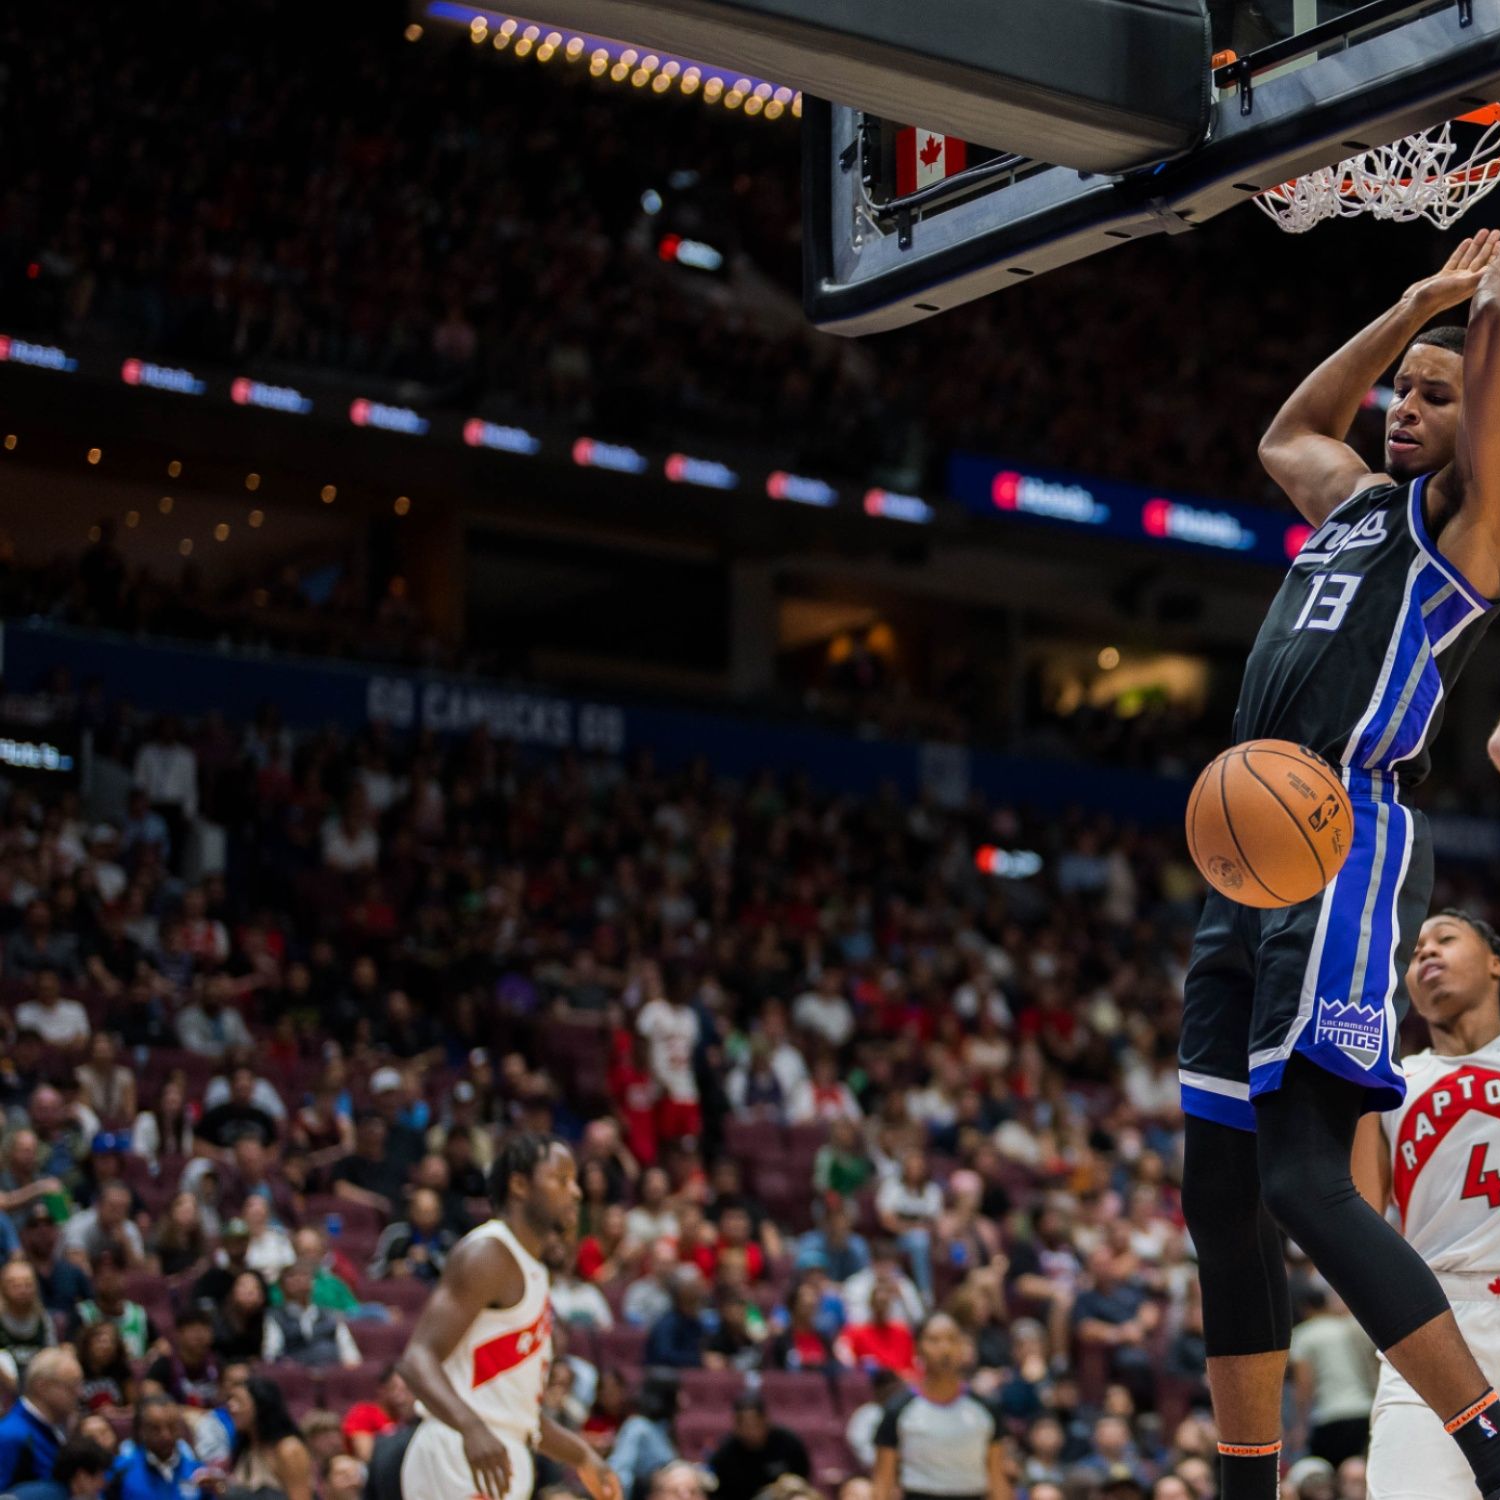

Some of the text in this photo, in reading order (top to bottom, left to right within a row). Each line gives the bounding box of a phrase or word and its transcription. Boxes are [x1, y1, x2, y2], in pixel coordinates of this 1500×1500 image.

[1294, 573, 1363, 631] 13
[1320, 1018, 1381, 1035] SACRAMENTO
[1319, 1028, 1381, 1052] KINGS
